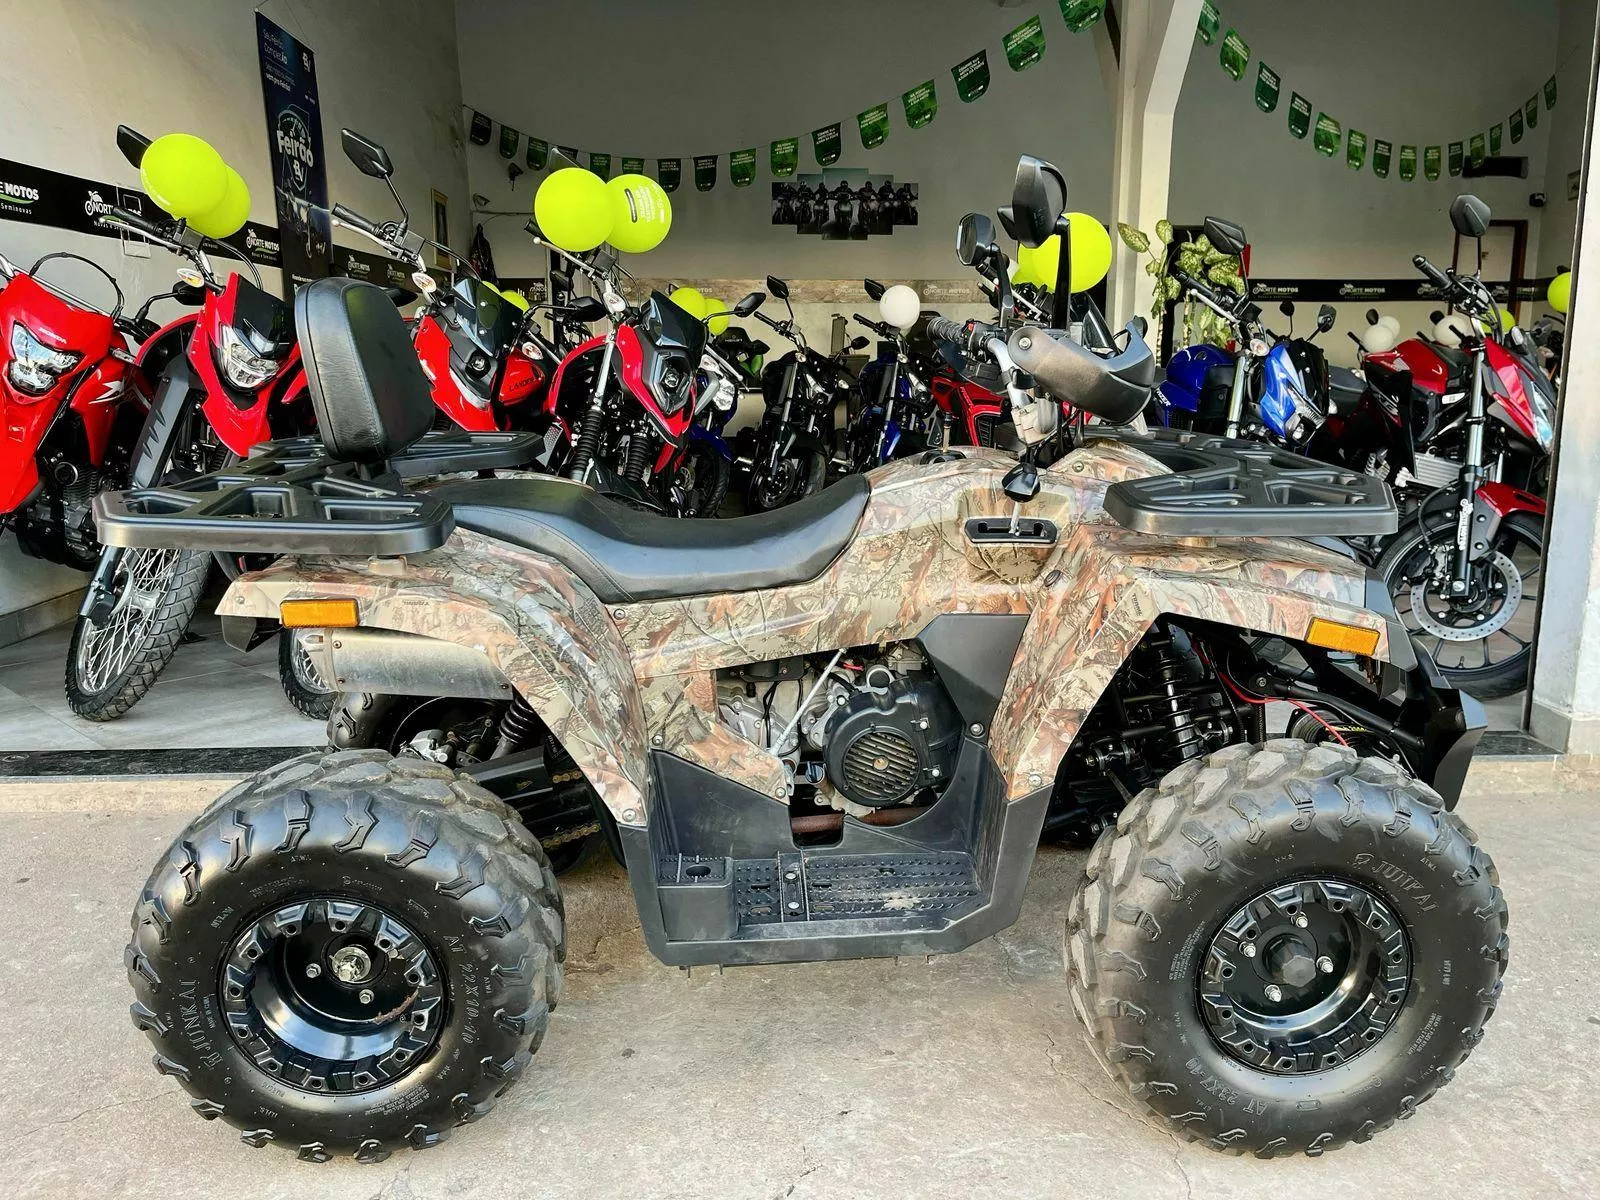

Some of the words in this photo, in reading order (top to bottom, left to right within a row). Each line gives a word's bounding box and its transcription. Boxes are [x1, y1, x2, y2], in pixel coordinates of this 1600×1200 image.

[276, 130, 314, 168] Feirão
[4, 183, 39, 200] MOTOS
[264, 241, 280, 252] MOTOS
